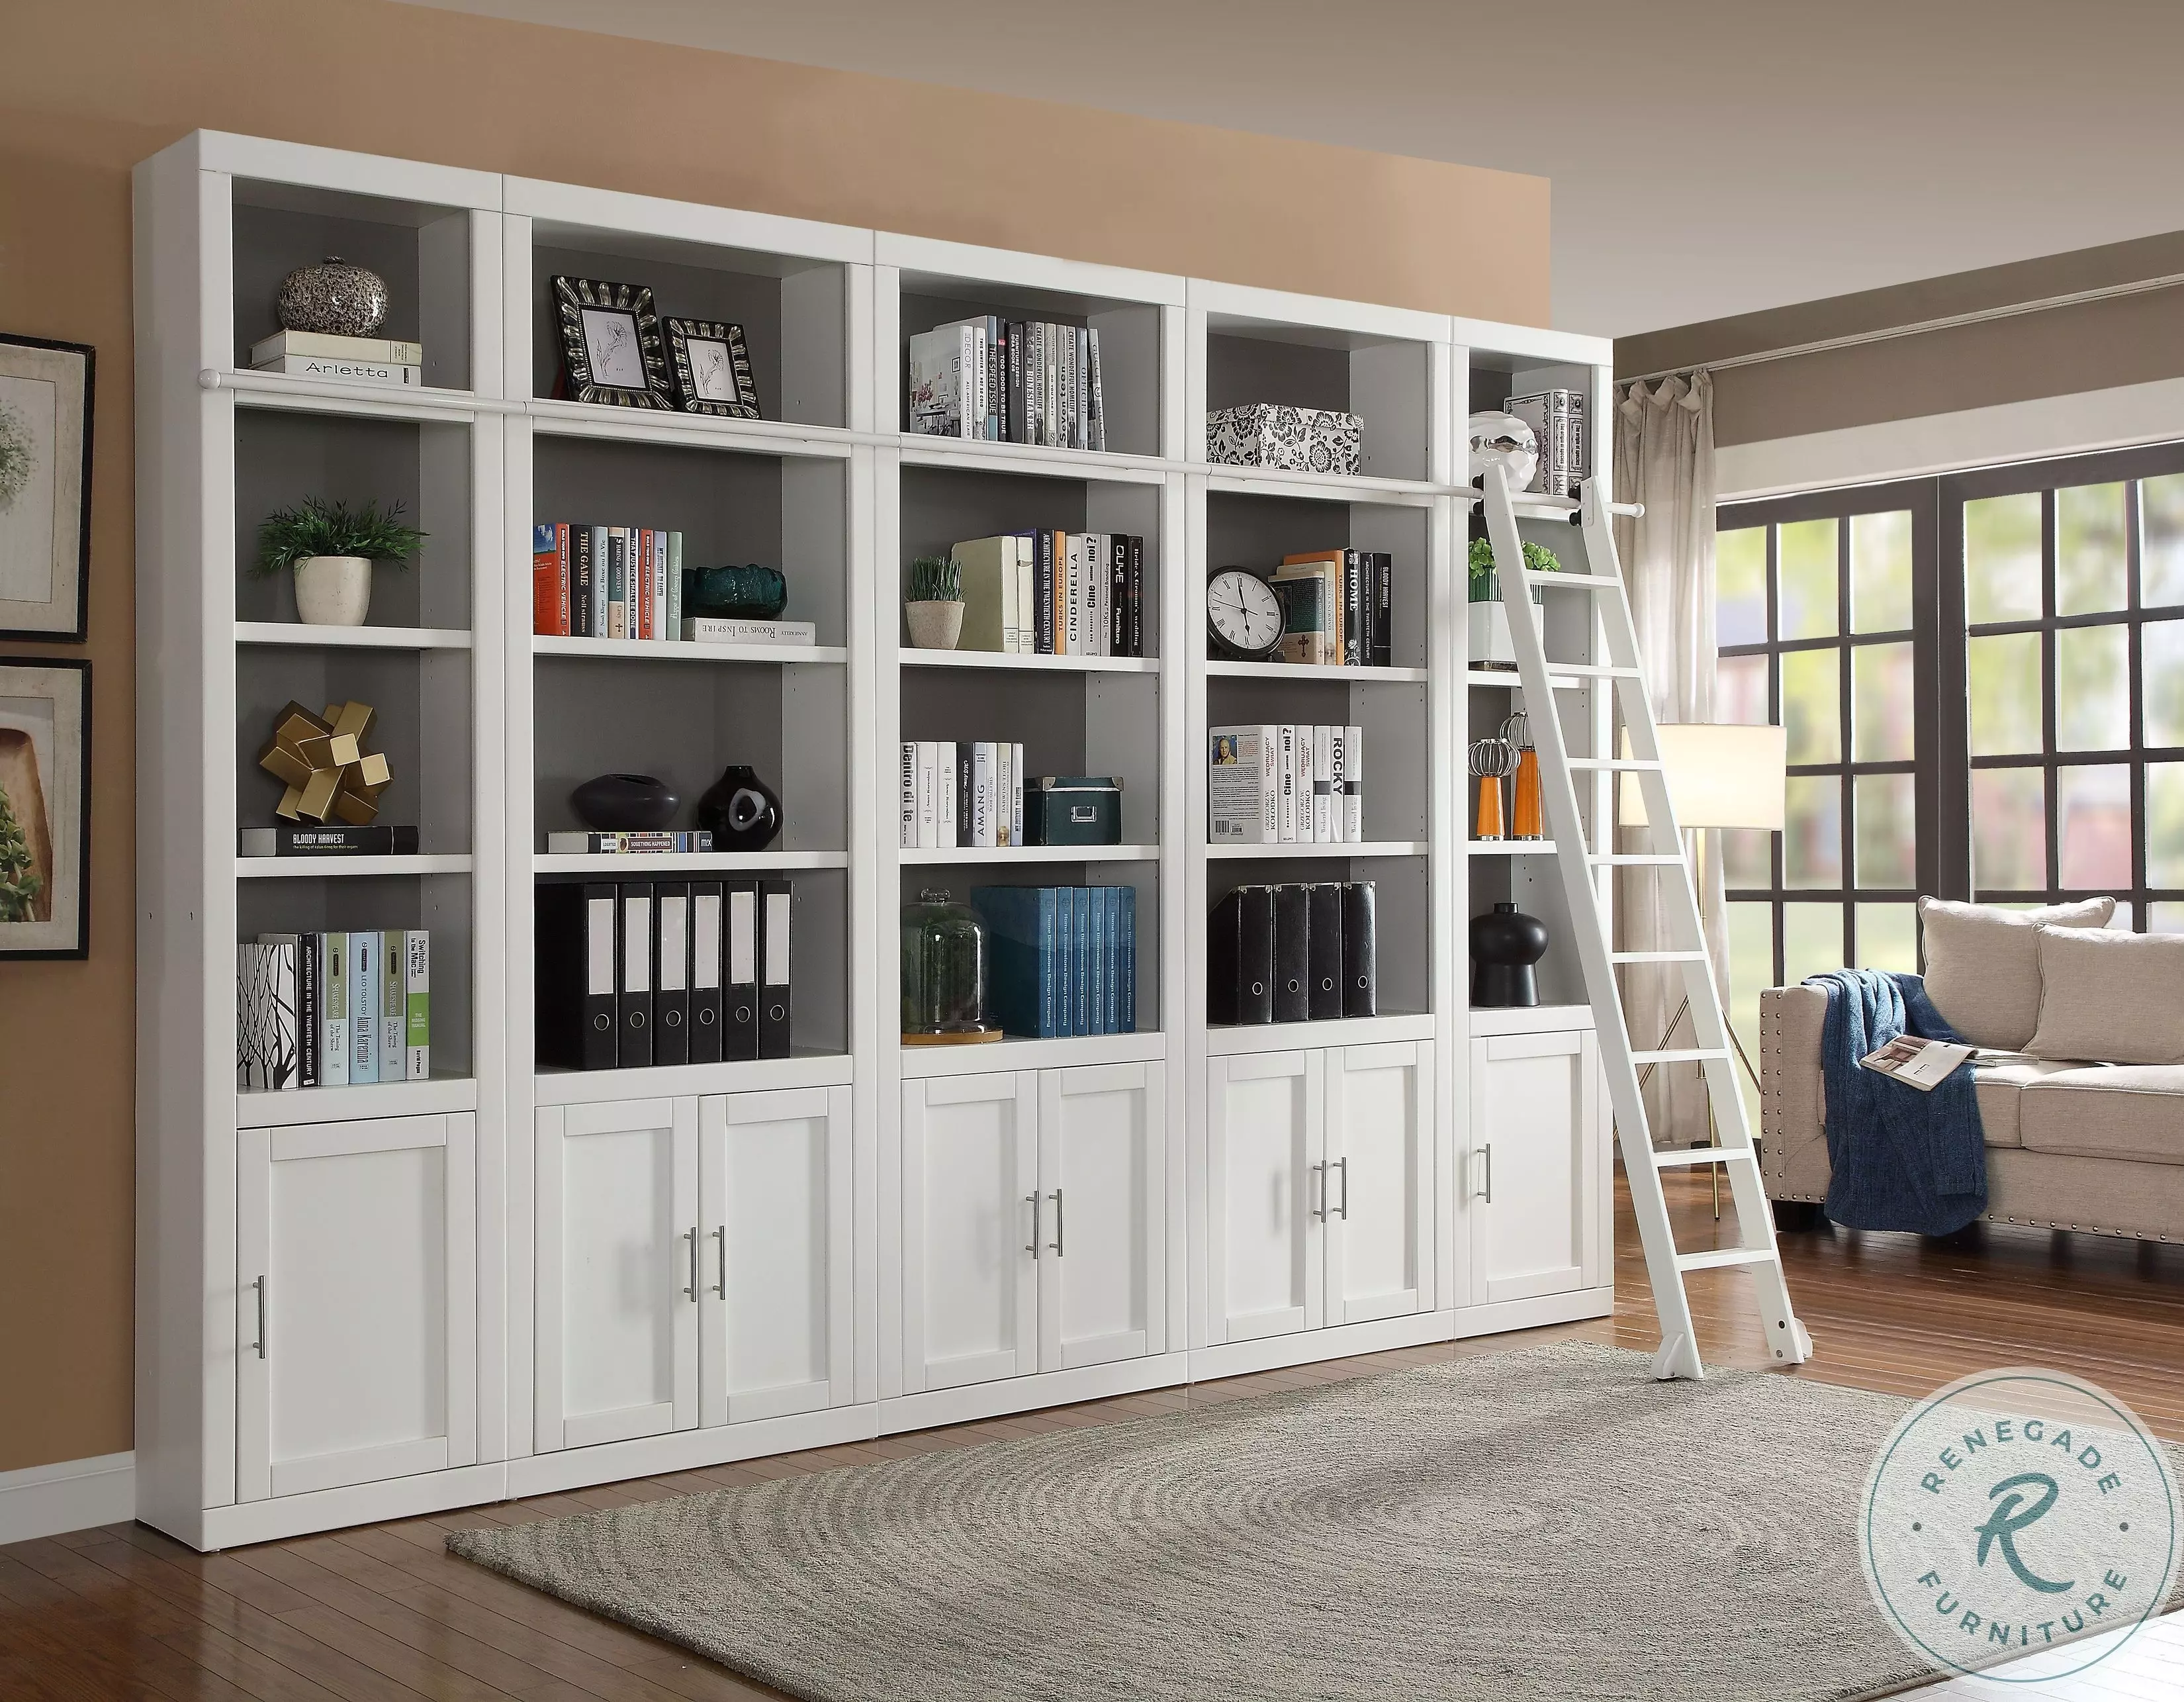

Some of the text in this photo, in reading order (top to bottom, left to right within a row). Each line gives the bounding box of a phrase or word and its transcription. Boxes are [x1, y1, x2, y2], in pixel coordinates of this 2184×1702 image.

[306, 362, 388, 378] Arletta
[988, 346, 997, 414] THE SPEED ISSUE
[1000, 393, 1006, 403] TO
[1001, 404, 1006, 414] BE
[1026, 370, 1034, 430] BONESHAKER
[580, 532, 588, 553] THE
[580, 555, 588, 586] GAME
[601, 558, 606, 567] ou
[1086, 536, 1097, 608] Cine noi?
[1058, 592, 1064, 602] IN
[1349, 569, 1359, 612] HOME
[1339, 601, 1343, 610] IN
[1283, 728, 1292, 752] noi?
[1333, 737, 1343, 795] ROCKY
[903, 745, 914, 823] Dentro di te
[293, 833, 345, 844] BLOODY HARVEST
[417, 939, 426, 974] Switching
[357, 1016, 372, 1033] Anna
[357, 1034, 372, 1064] Karenina
